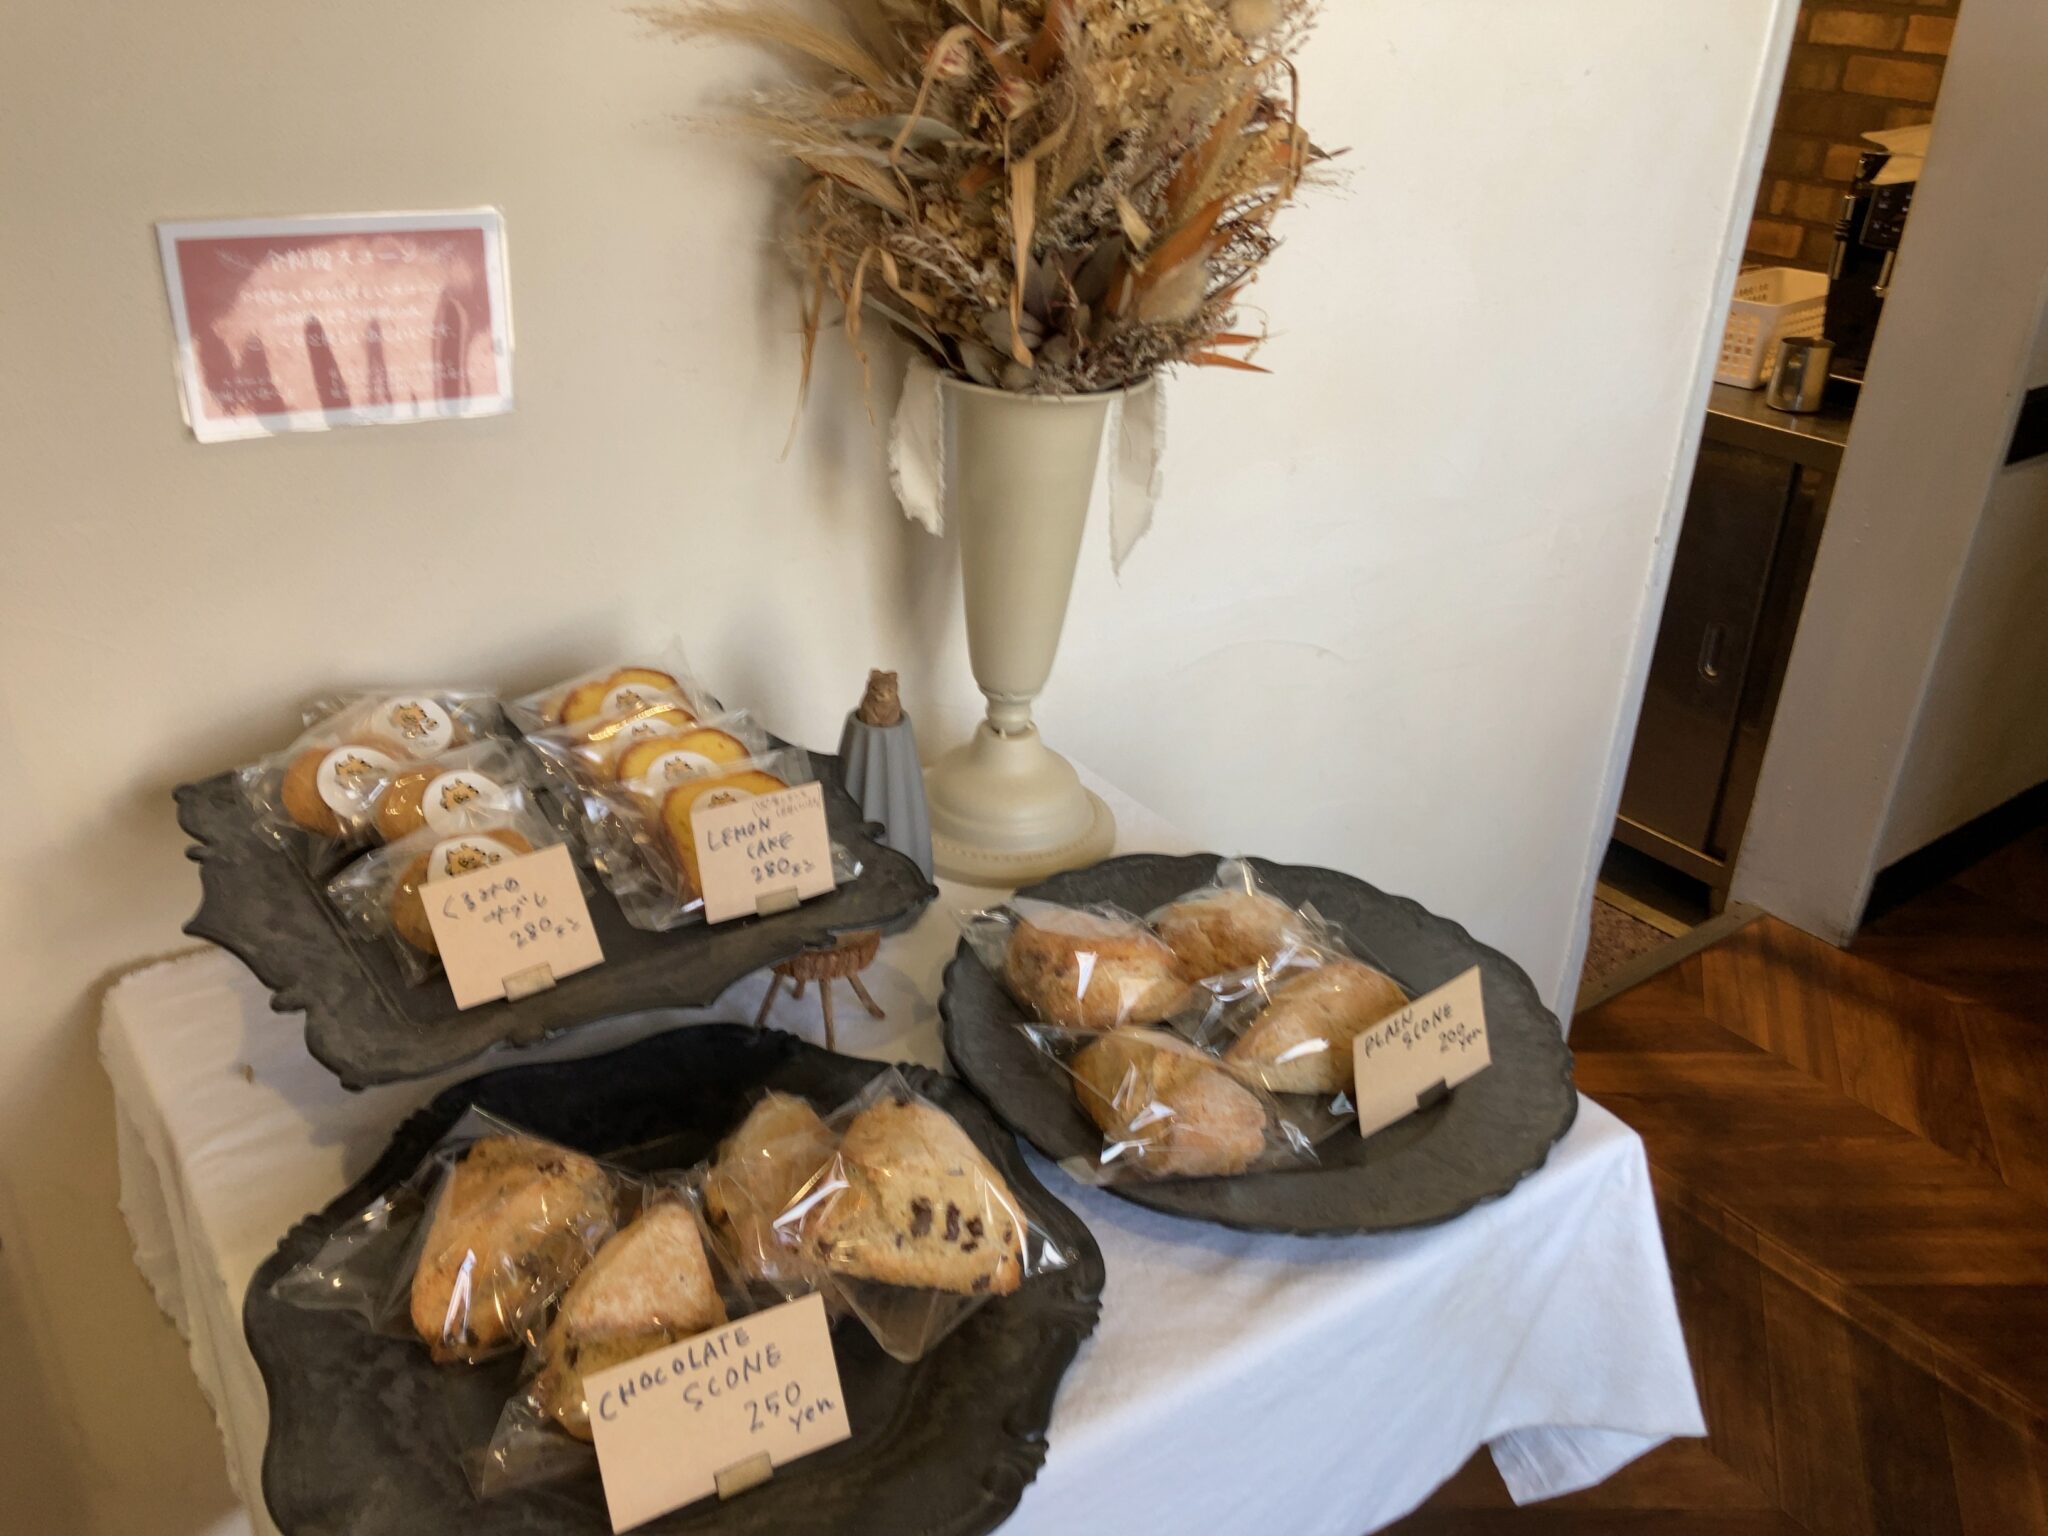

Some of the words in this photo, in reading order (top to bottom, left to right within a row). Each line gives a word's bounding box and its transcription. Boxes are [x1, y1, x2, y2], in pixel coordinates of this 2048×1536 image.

[707, 816, 770, 851] LEMON
[746, 831, 792, 859] CAKE
[1365, 1008, 1413, 1058] PLAIN
[1402, 1004, 1452, 1050] SCONE
[599, 1327, 750, 1421] CHOCOLATE
[683, 1343, 781, 1410] SCONE
[745, 1381, 801, 1432] 250
